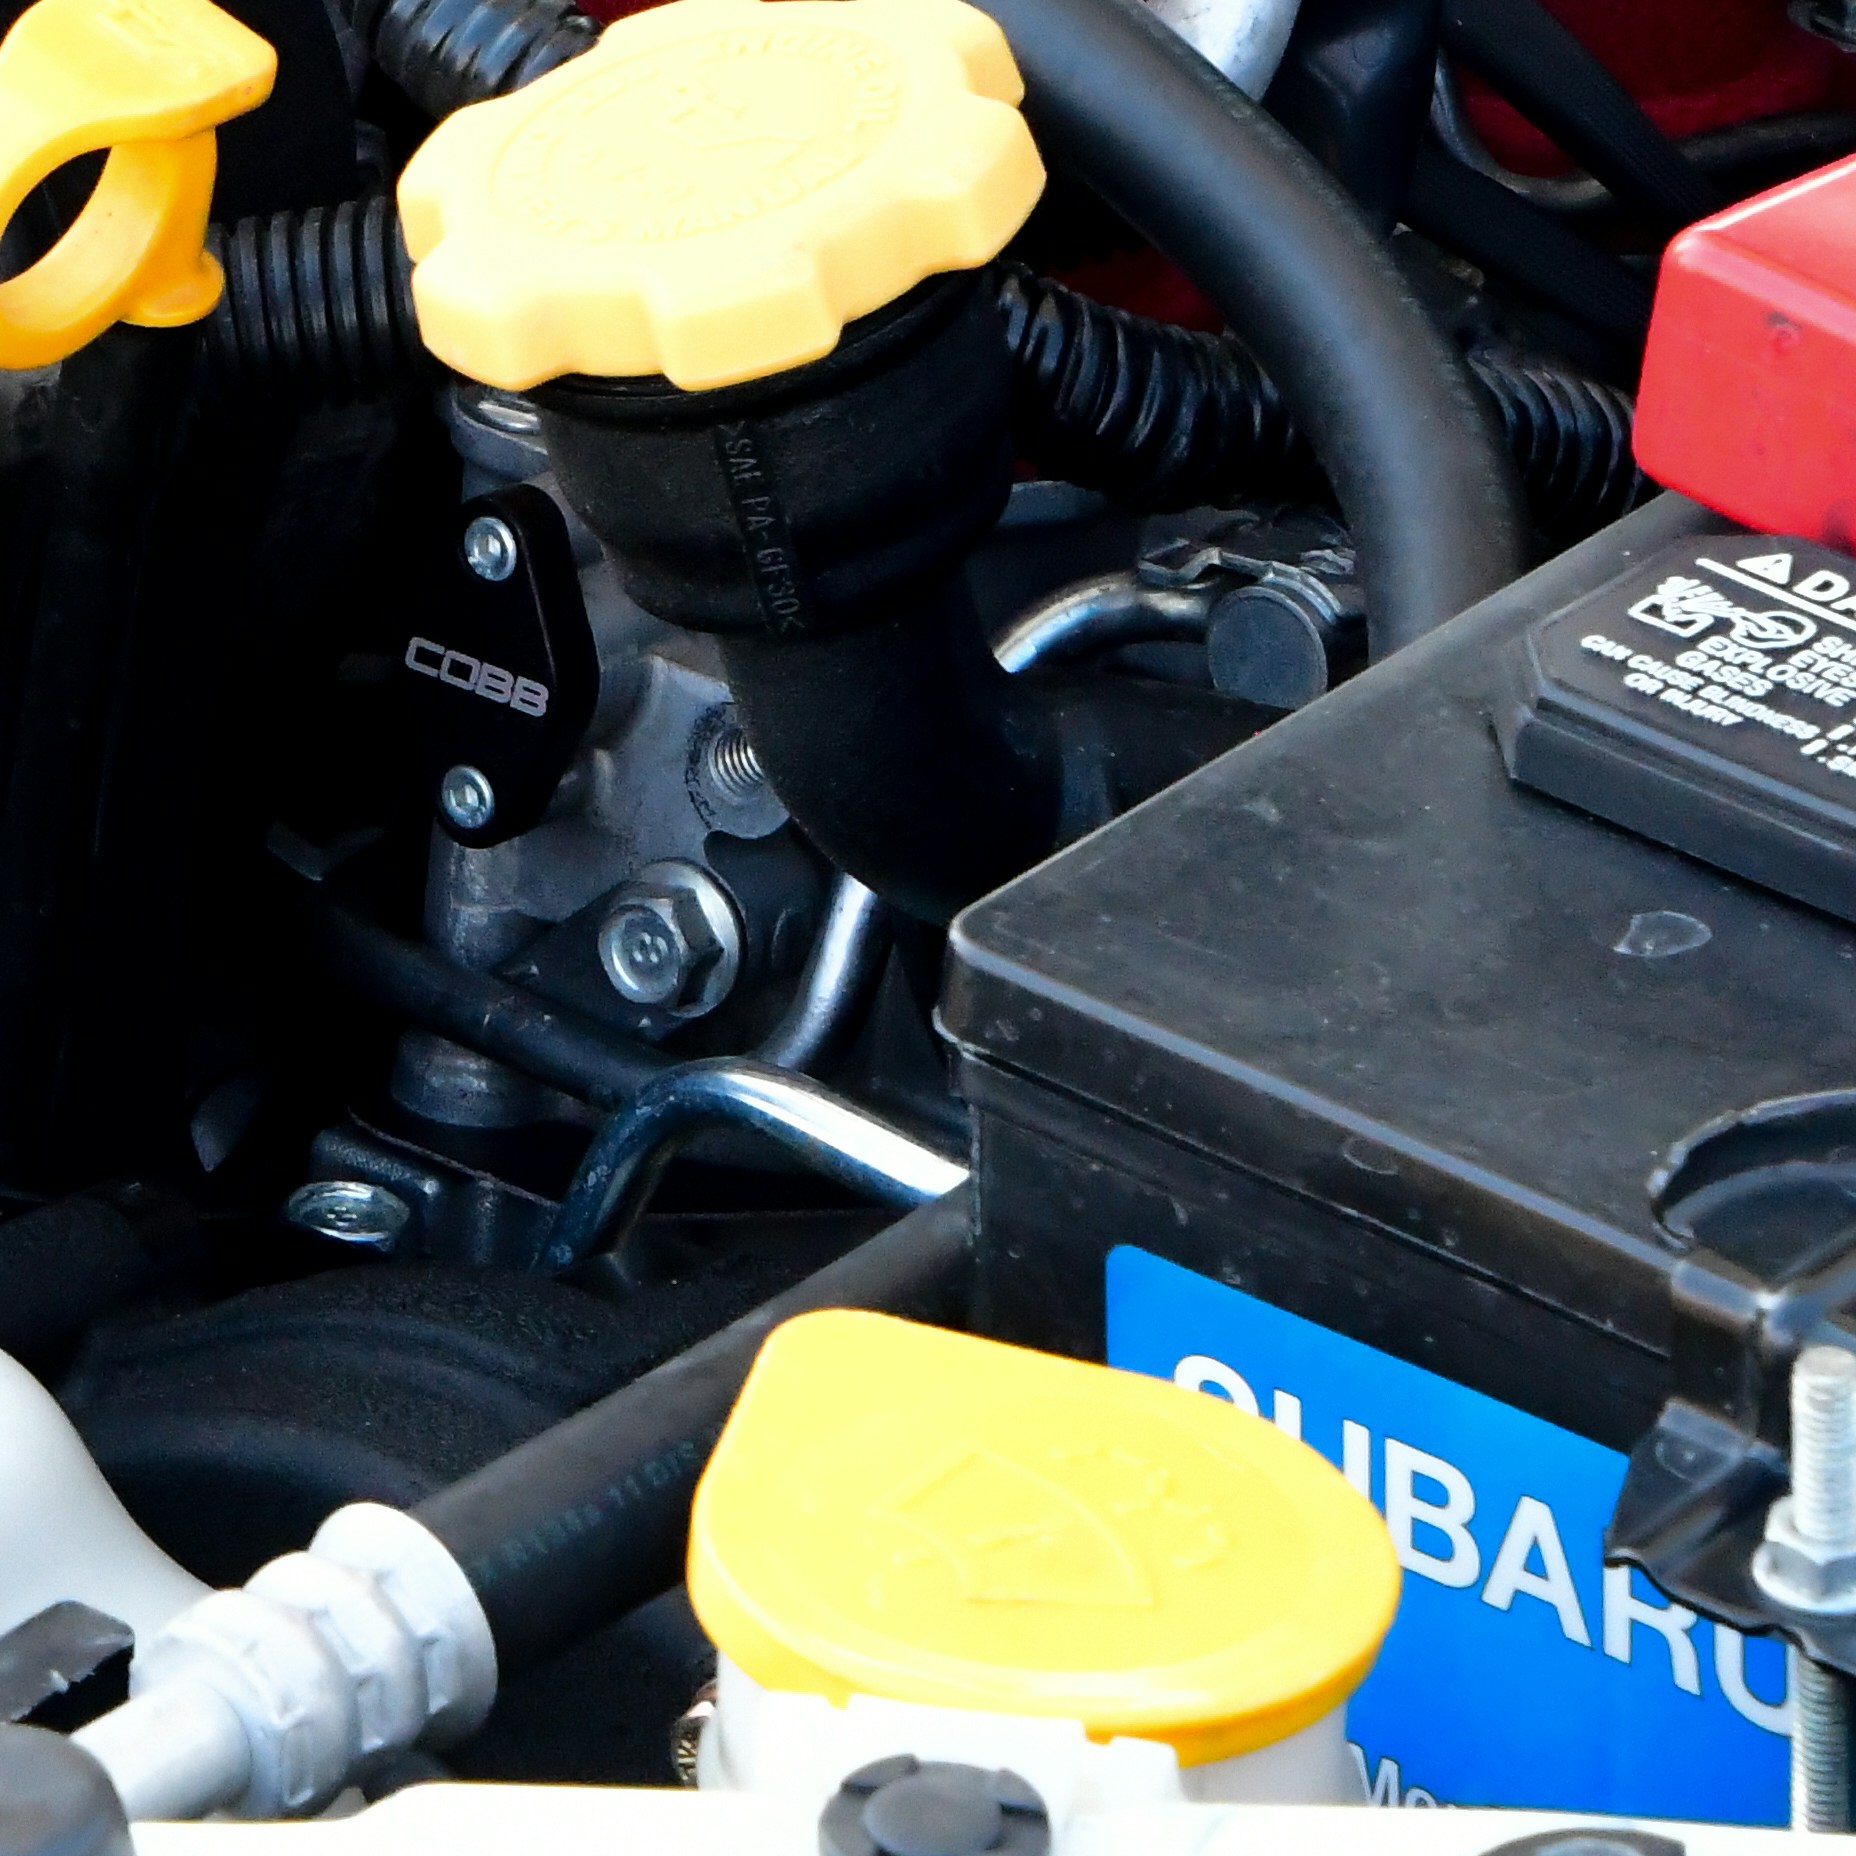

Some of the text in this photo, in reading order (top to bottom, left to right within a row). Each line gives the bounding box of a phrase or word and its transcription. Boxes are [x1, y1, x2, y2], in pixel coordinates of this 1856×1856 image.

[404, 636, 550, 718] COBB
[1580, 634, 1821, 739] CAN CAUSE BLINDNESS
[1623, 672, 1744, 726] OR INJURY
[1675, 650, 1773, 697] GASES
[1697, 636, 1856, 707] EXPLOSIVE
